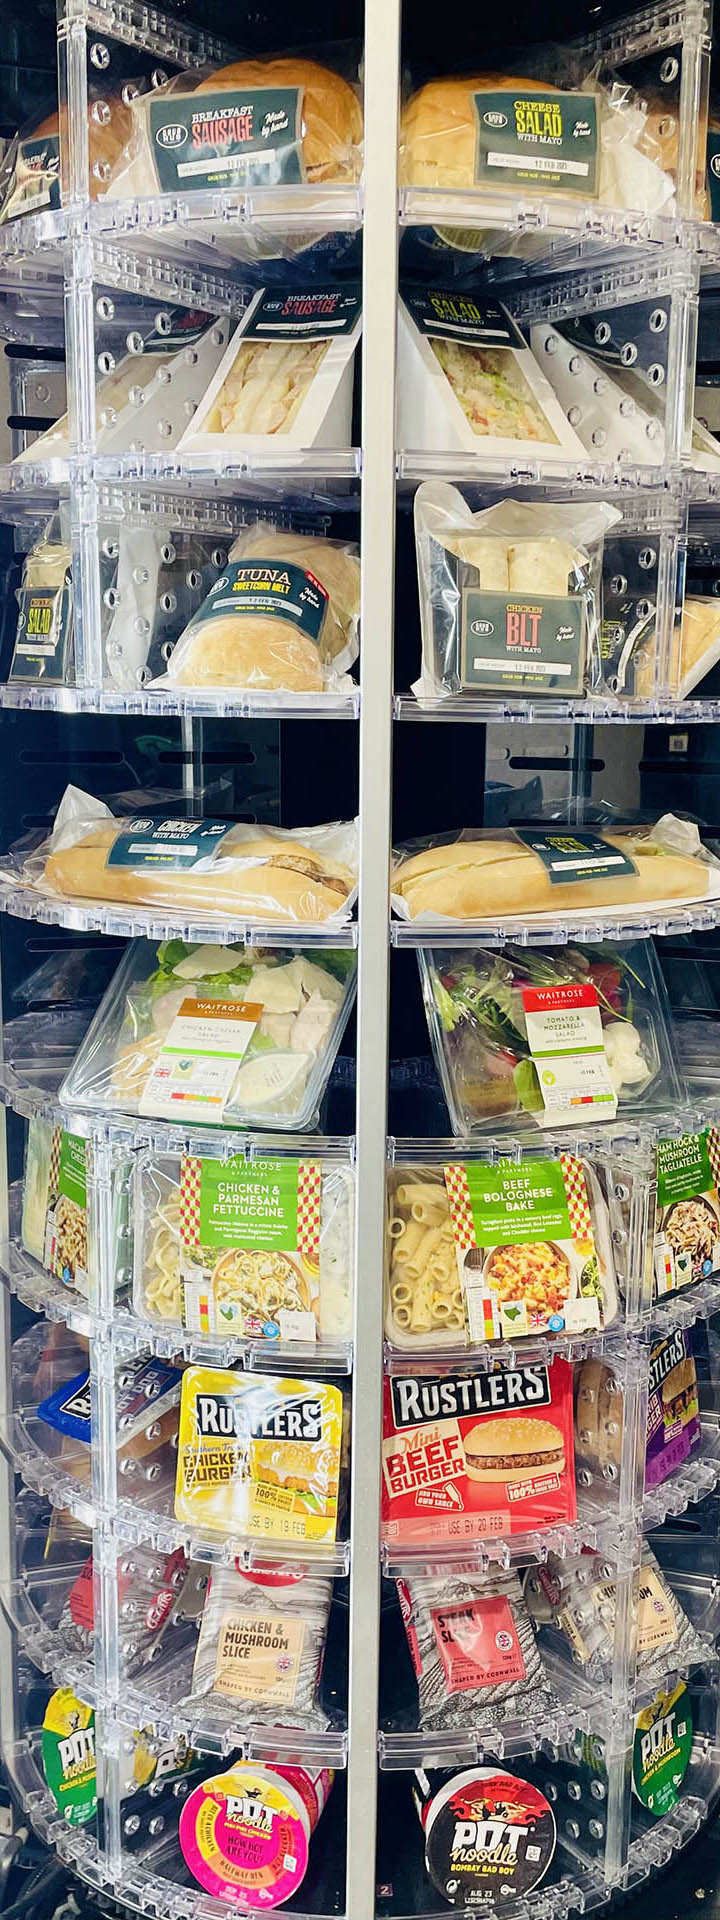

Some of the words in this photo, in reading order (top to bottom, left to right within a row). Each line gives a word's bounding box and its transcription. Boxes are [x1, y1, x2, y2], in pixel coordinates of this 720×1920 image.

[192, 106, 254, 123] BREAKFAST
[514, 101, 560, 113] CHEESE
[515, 110, 562, 137] SALAD
[192, 116, 254, 150] SAUSAGE
[517, 132, 538, 143] WITH
[539, 136, 562, 146] MAYO
[287, 293, 341, 302] BREAKFAST
[281, 299, 336, 315] SAUSAGE
[430, 298, 481, 320] SALAD
[237, 568, 292, 585] TUNA
[232, 580, 272, 592] SWEETCORN
[271, 582, 291, 594] MELT
[27, 607, 51, 634] SALAD
[506, 612, 542, 647] BLT
[505, 645, 523, 653] WITH
[523, 646, 542, 654] MAYO
[536, 989, 584, 1000] WAITROSE
[196, 1002, 247, 1012] WAITROSE
[543, 1023, 584, 1031] MOZZARELLA
[657, 1143, 673, 1154] HAM
[673, 1136, 694, 1149] HOCK
[659, 1144, 700, 1164] MUSHROOM
[219, 1159, 281, 1171] WAITROSE
[660, 1153, 703, 1174] TAGLIATELLE
[217, 1182, 269, 1194] CHICKEN
[272, 1185, 280, 1195] &
[503, 1179, 530, 1190] BEEF
[218, 1193, 279, 1206] PARMESAN
[483, 1187, 553, 1203] BOLOGNESE
[213, 1204, 284, 1217] FETTUCCINE
[506, 1200, 535, 1212] BAKE
[648, 1329, 684, 1391] STLERS
[396, 1367, 545, 1422] RUSTLERS
[199, 1397, 322, 1440] RULERS
[400, 1427, 441, 1453] Mini
[183, 1451, 248, 1467] CHICKEN
[386, 1435, 460, 1478] BEEF
[391, 1458, 465, 1493] BURGER
[256, 1487, 277, 1500] 100%
[431, 1491, 447, 1499] YOUR
[509, 1486, 535, 1500] 100%
[434, 1499, 453, 1508] SAUCE
[264, 1517, 273, 1529] BY
[292, 1521, 306, 1535] FEB
[448, 1521, 461, 1534] USE
[464, 1519, 474, 1533] BY
[477, 1518, 487, 1531] 20
[489, 1516, 503, 1530] FEB
[227, 1617, 272, 1635] CHICKEN
[275, 1623, 284, 1635] &
[224, 1631, 289, 1650] MUSHROOM
[647, 1629, 673, 1642] CORNWALL
[222, 1645, 251, 1659] SLICE
[486, 1667, 520, 1678] CORNWALL
[218, 1680, 243, 1691] SHAPED
[640, 1712, 676, 1763] POT
[57, 1727, 96, 1772] POT
[642, 1735, 675, 1773] noodle
[63, 1752, 96, 1780] noodl
[225, 1795, 280, 1825] POT
[226, 1812, 274, 1833] noodle
[228, 1836, 246, 1848] HOW
[248, 1841, 264, 1854] HOT
[451, 1821, 529, 1853] POT
[226, 1846, 242, 1857] ARE
[243, 1850, 264, 1864] YOU?
[449, 1842, 518, 1866] noodle
[450, 1863, 481, 1873] BOMBAY
[482, 1865, 497, 1873] BAD
[498, 1867, 515, 1876] BOY
[380, 1885, 389, 1895] 2
[470, 1889, 482, 1897] AUG
